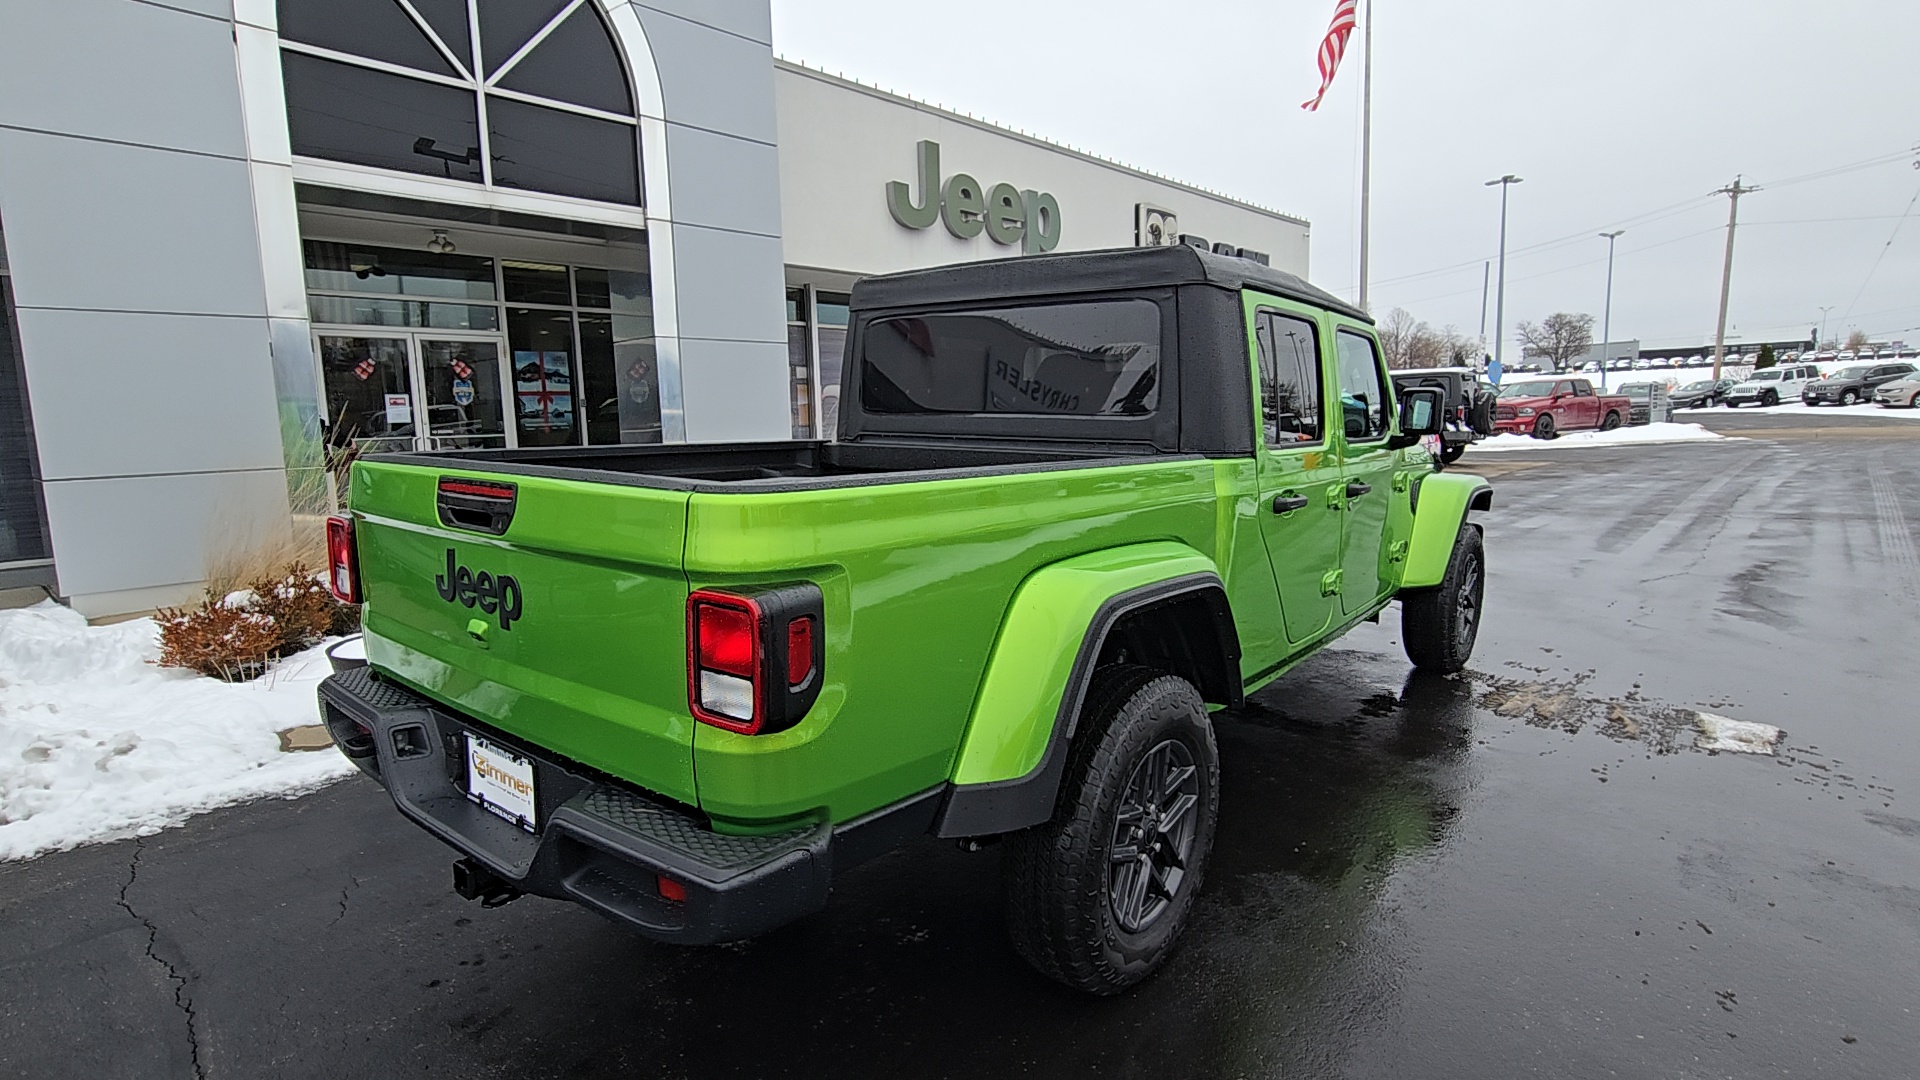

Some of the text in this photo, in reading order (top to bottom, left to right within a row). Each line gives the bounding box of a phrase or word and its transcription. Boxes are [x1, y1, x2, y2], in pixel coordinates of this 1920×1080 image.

[886, 140, 1061, 254] Jeep
[436, 548, 522, 631] Jeep
[475, 754, 533, 796] Zimmer
